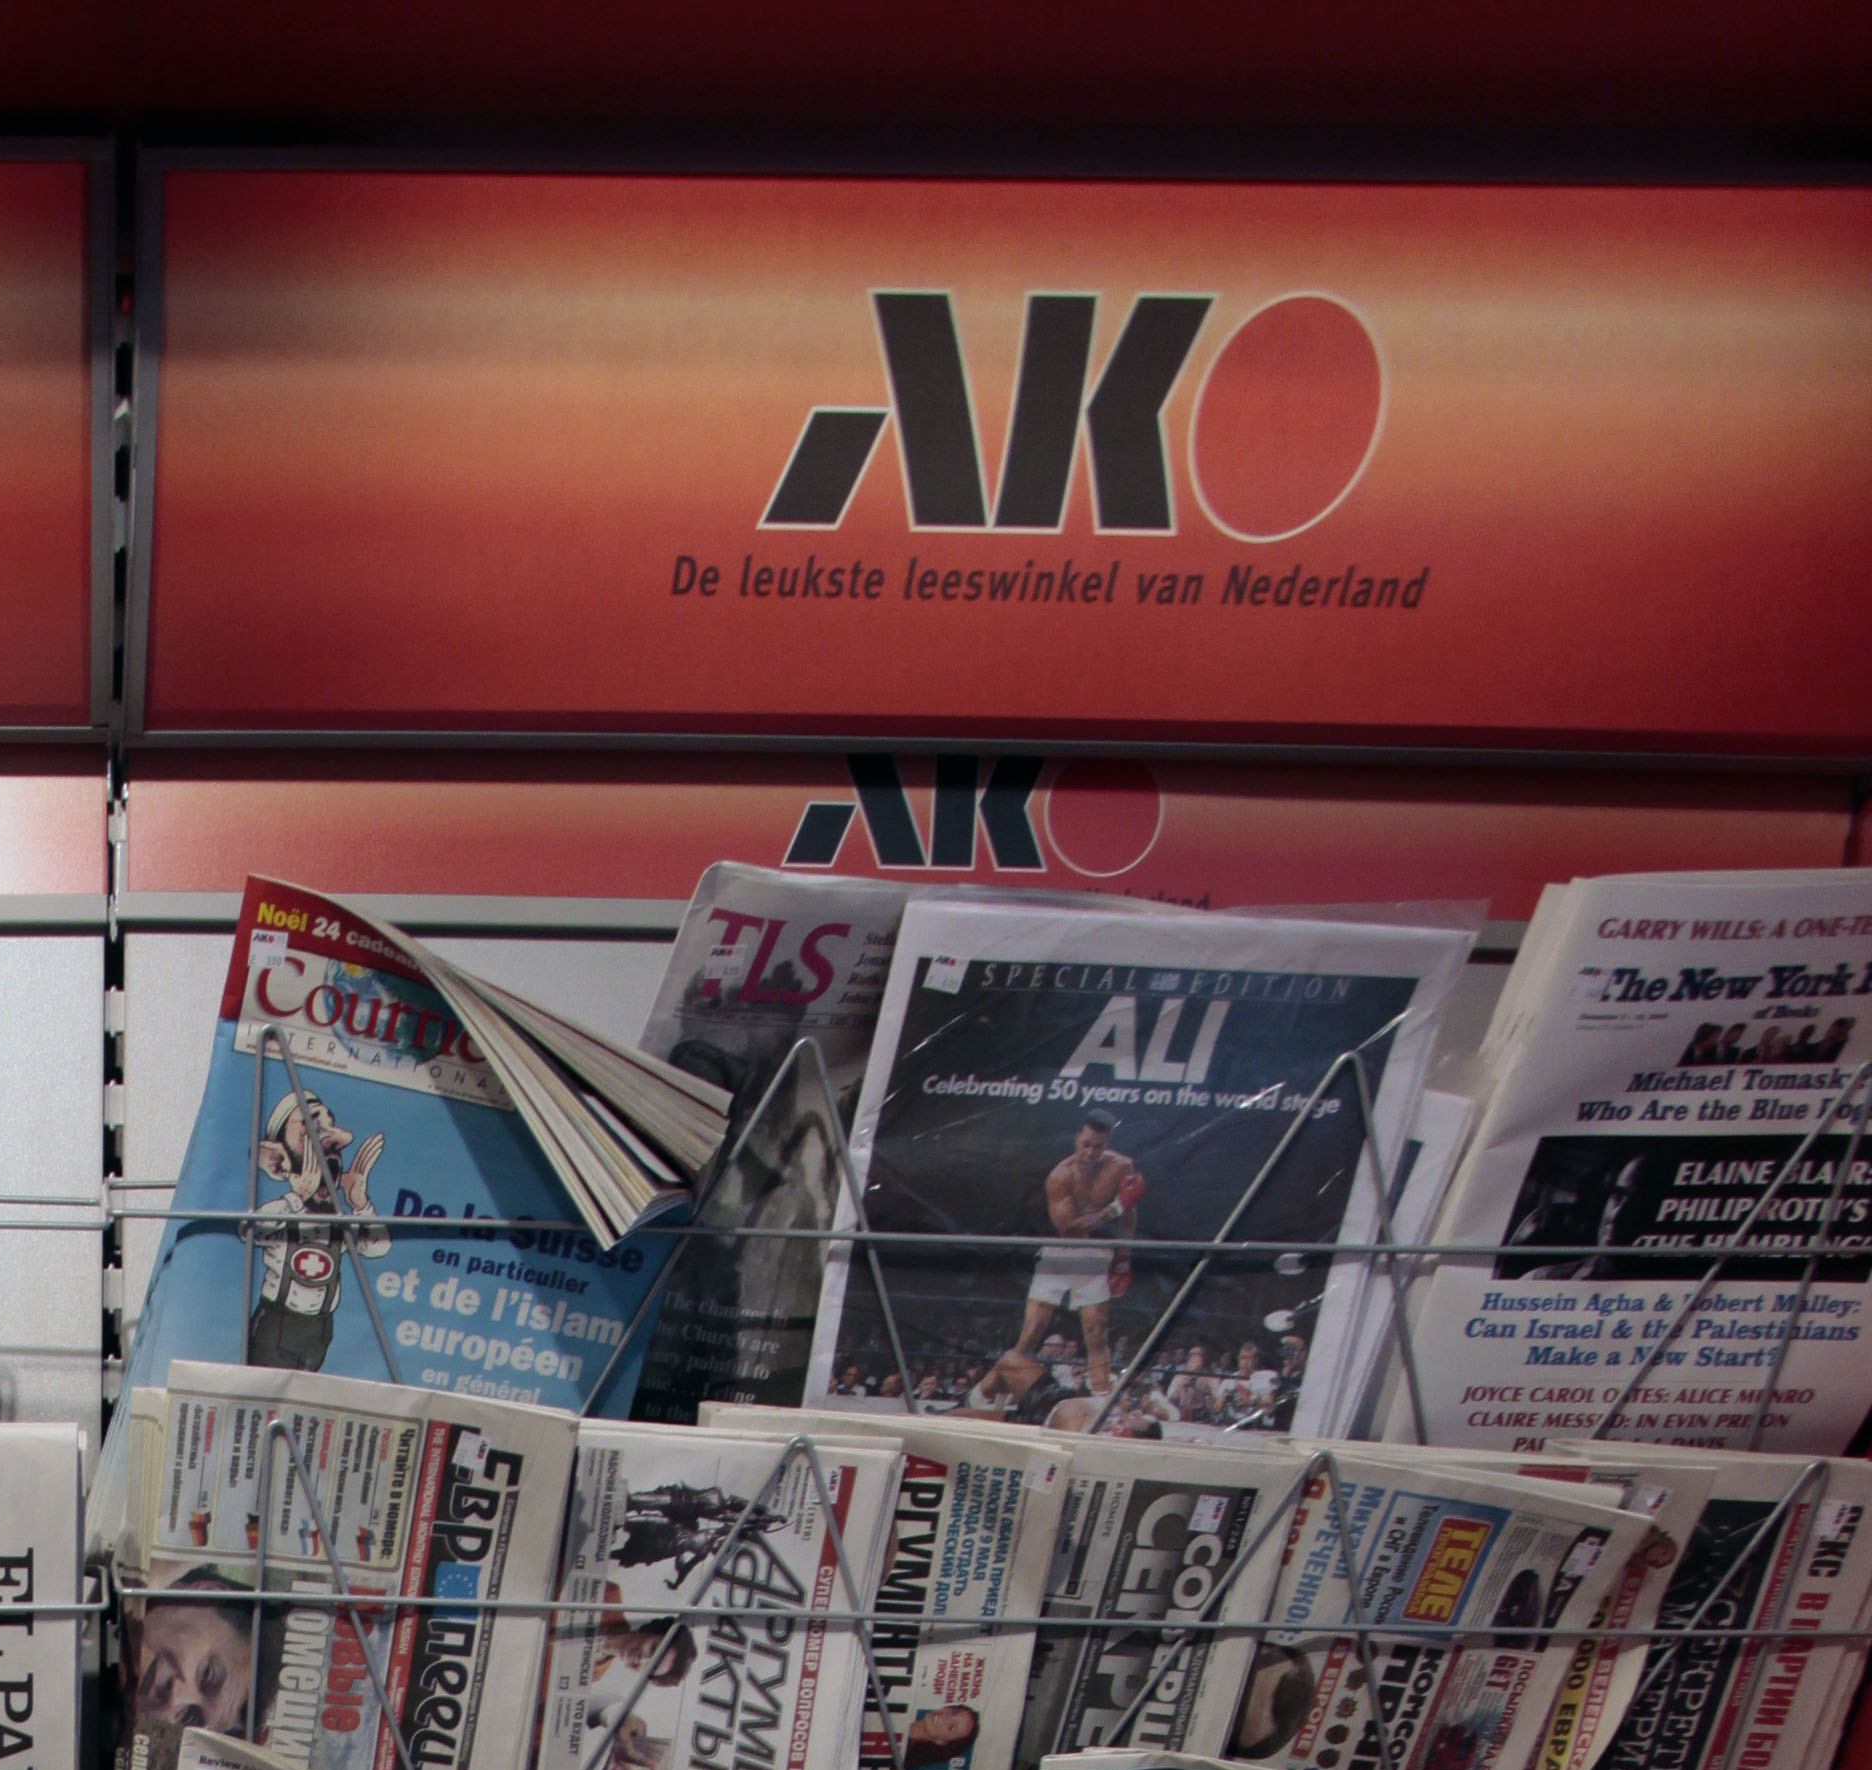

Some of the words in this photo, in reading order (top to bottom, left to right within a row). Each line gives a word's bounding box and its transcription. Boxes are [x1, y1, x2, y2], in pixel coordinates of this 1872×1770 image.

[756, 287, 1387, 544] AKO
[670, 554, 721, 598] De
[739, 558, 885, 601] leukste
[905, 557, 1118, 605] leeswinkel
[1136, 567, 1204, 605] van
[1221, 564, 1432, 610] Nederland
[781, 753, 1164, 878] AKO
[257, 901, 308, 934] Noël
[313, 915, 341, 941] 24
[700, 908, 851, 1002] TLS
[982, 962, 1139, 992] SPECIAL
[1189, 970, 1352, 1000] EDITION
[1664, 966, 1760, 1001] New
[1767, 964, 1850, 999] York
[255, 955, 489, 1065] Courrie
[1059, 996, 1231, 1084] ALI
[922, 1075, 1042, 1103] Celebrating
[1048, 1078, 1077, 1101] 50
[1079, 1082, 1137, 1108] years
[1142, 1086, 1170, 1106] on
[1175, 1086, 1209, 1108] the
[1214, 1089, 1276, 1111] world
[1280, 1092, 1340, 1119] stage
[376, 1267, 420, 1298] et
[430, 1274, 480, 1315] de
[432, 1245, 461, 1268] en
[463, 1253, 588, 1296] particulier
[395, 1315, 582, 1381] européen
